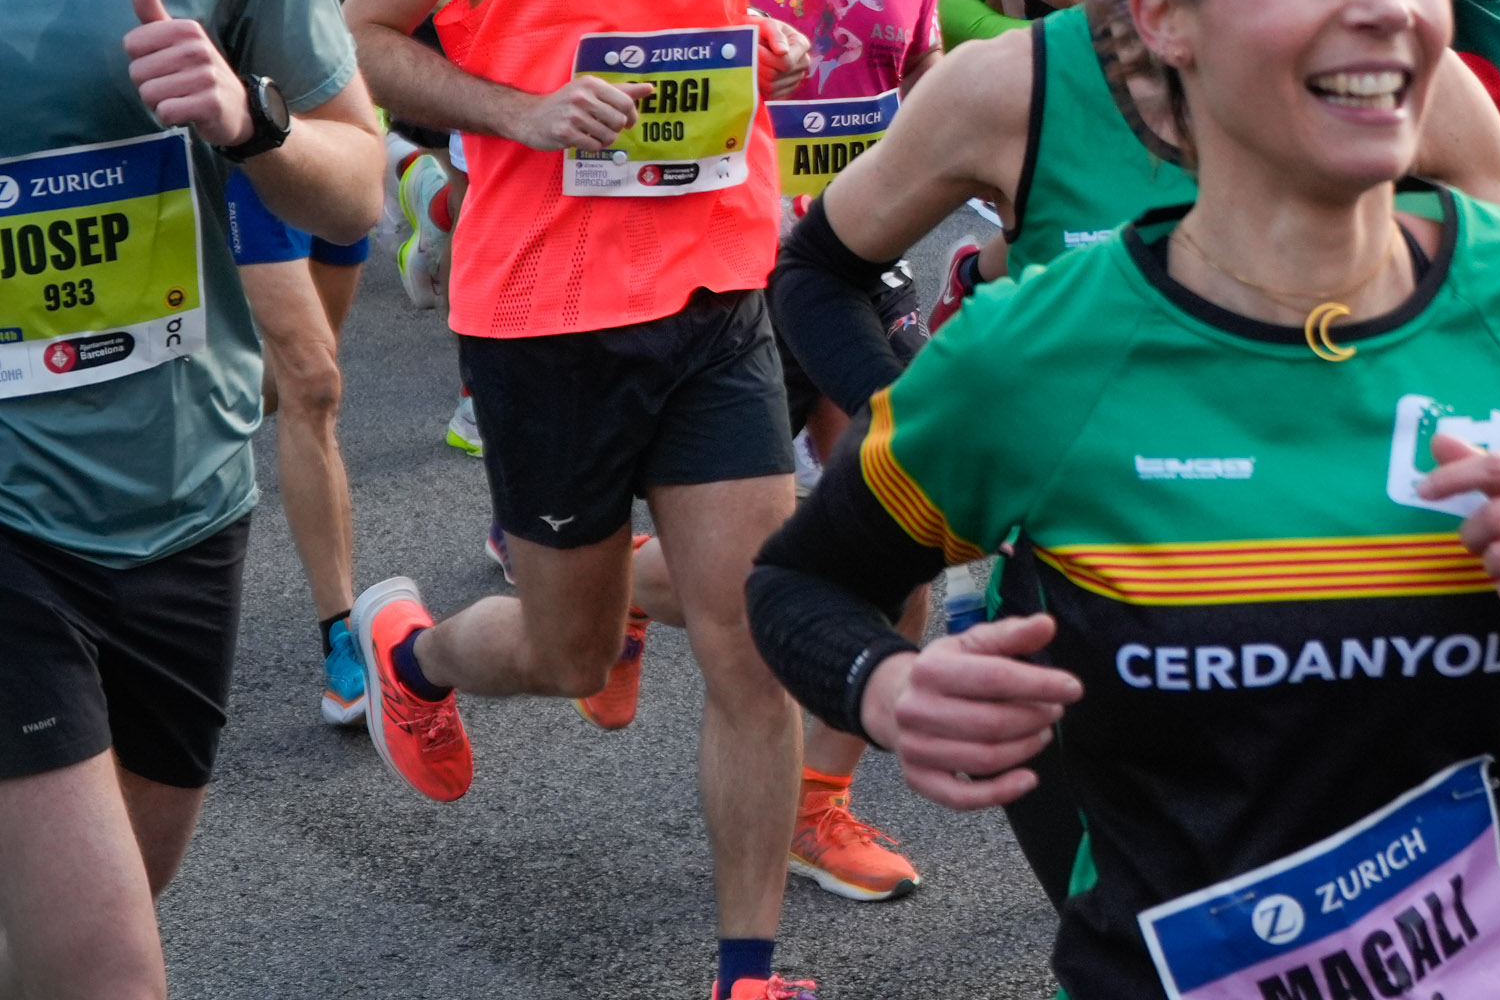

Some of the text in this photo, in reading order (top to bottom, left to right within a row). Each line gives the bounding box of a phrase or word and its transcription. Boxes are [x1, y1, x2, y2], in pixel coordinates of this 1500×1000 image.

[650, 46, 711, 62] ZURICH
[642, 120, 684, 143] 1060
[831, 112, 881, 127] ZURICH
[793, 139, 882, 175] ANDR
[30, 166, 124, 197] ZURICH
[0, 212, 129, 279] JOSEP
[43, 278, 95, 312] 933
[80, 344, 125, 361] Barcelona
[1315, 826, 1428, 914] ZURICH
